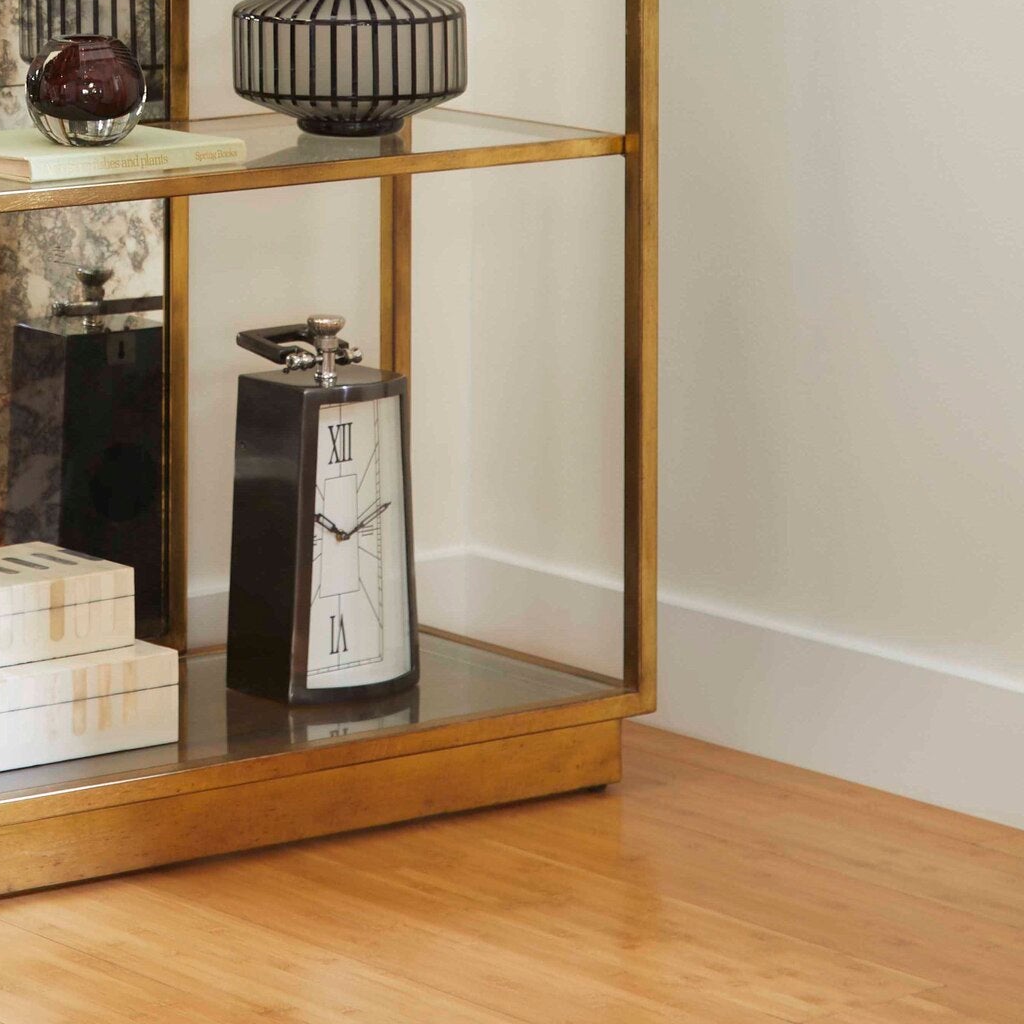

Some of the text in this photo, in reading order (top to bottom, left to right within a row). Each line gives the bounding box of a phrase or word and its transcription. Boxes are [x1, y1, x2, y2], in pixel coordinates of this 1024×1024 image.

[121, 154, 139, 167] and
[140, 152, 169, 169] plants
[195, 150, 217, 161] Spring
[217, 149, 238, 159] Books
[328, 422, 353, 465] XII
